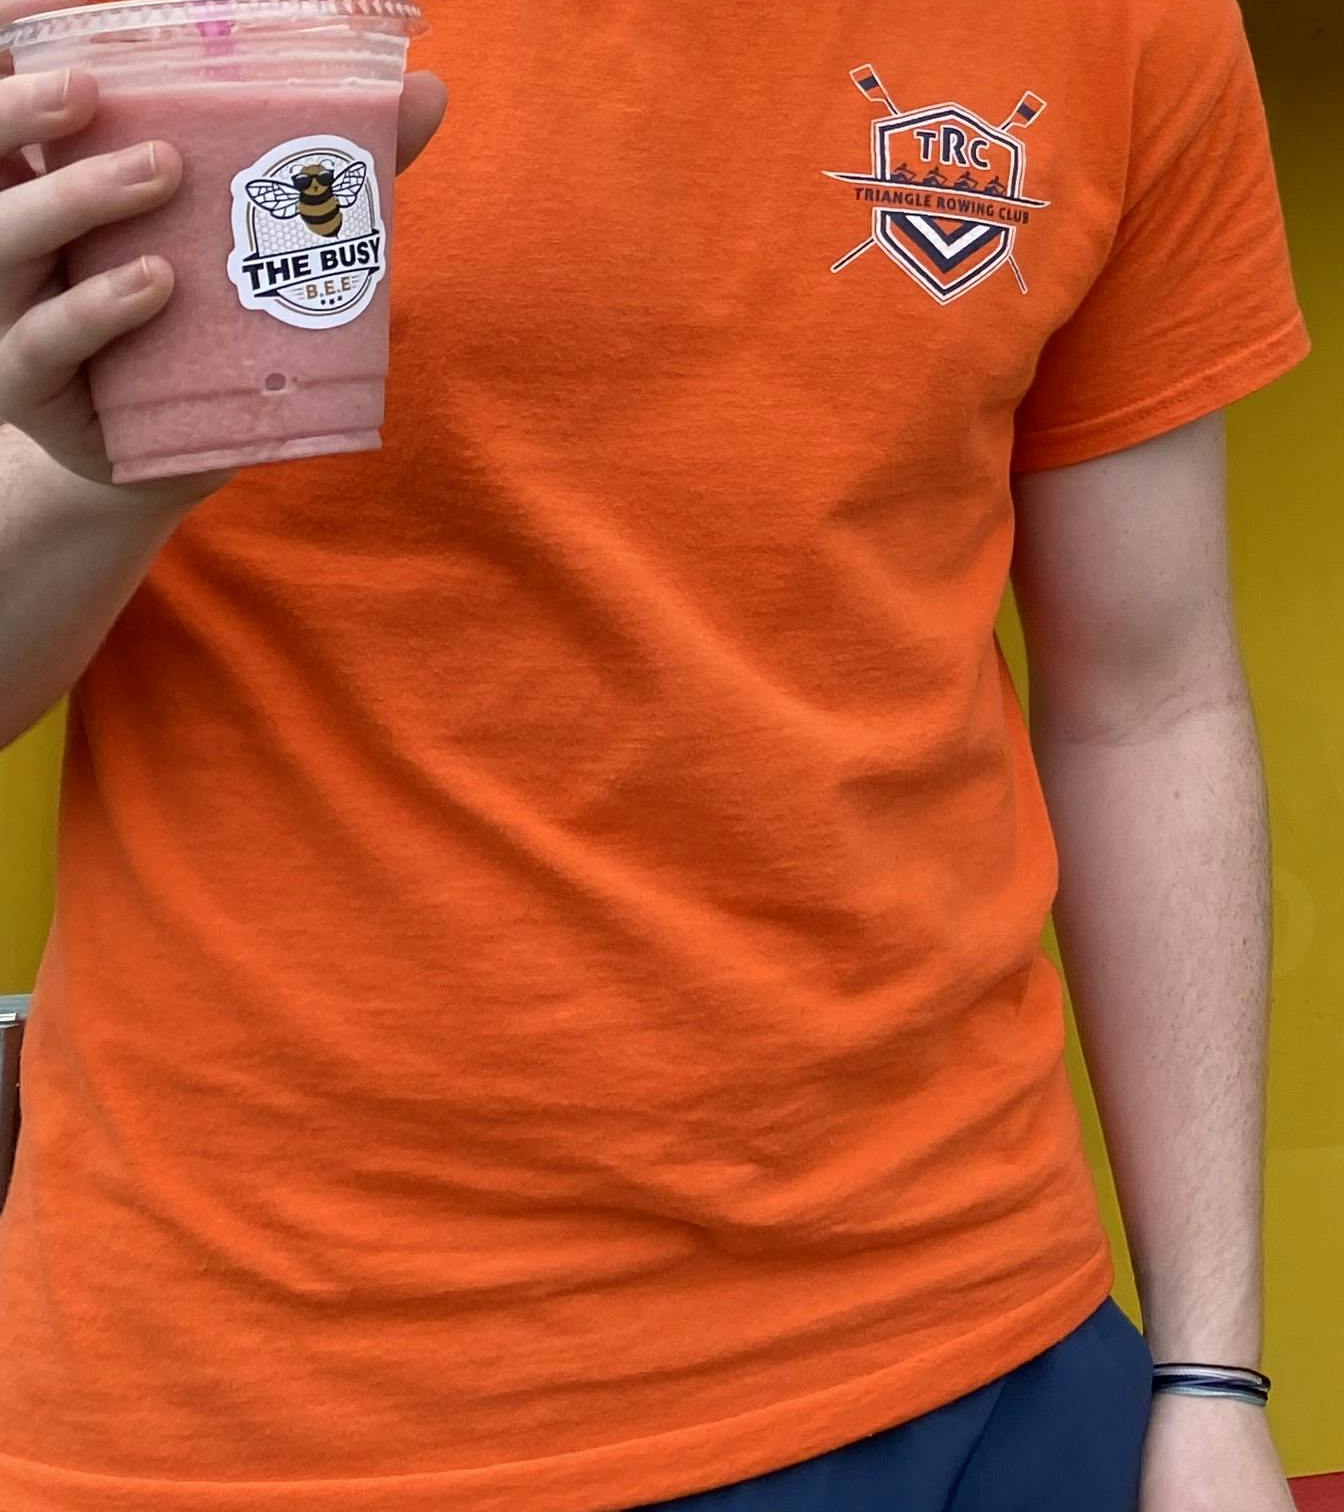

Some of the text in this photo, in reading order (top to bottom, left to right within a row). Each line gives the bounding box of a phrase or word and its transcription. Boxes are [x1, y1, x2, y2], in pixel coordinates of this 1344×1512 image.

[914, 124, 991, 170] TRC
[854, 187, 1030, 225] TRIANGLE ROWING CLUB
[242, 237, 381, 291] THE BUSY
